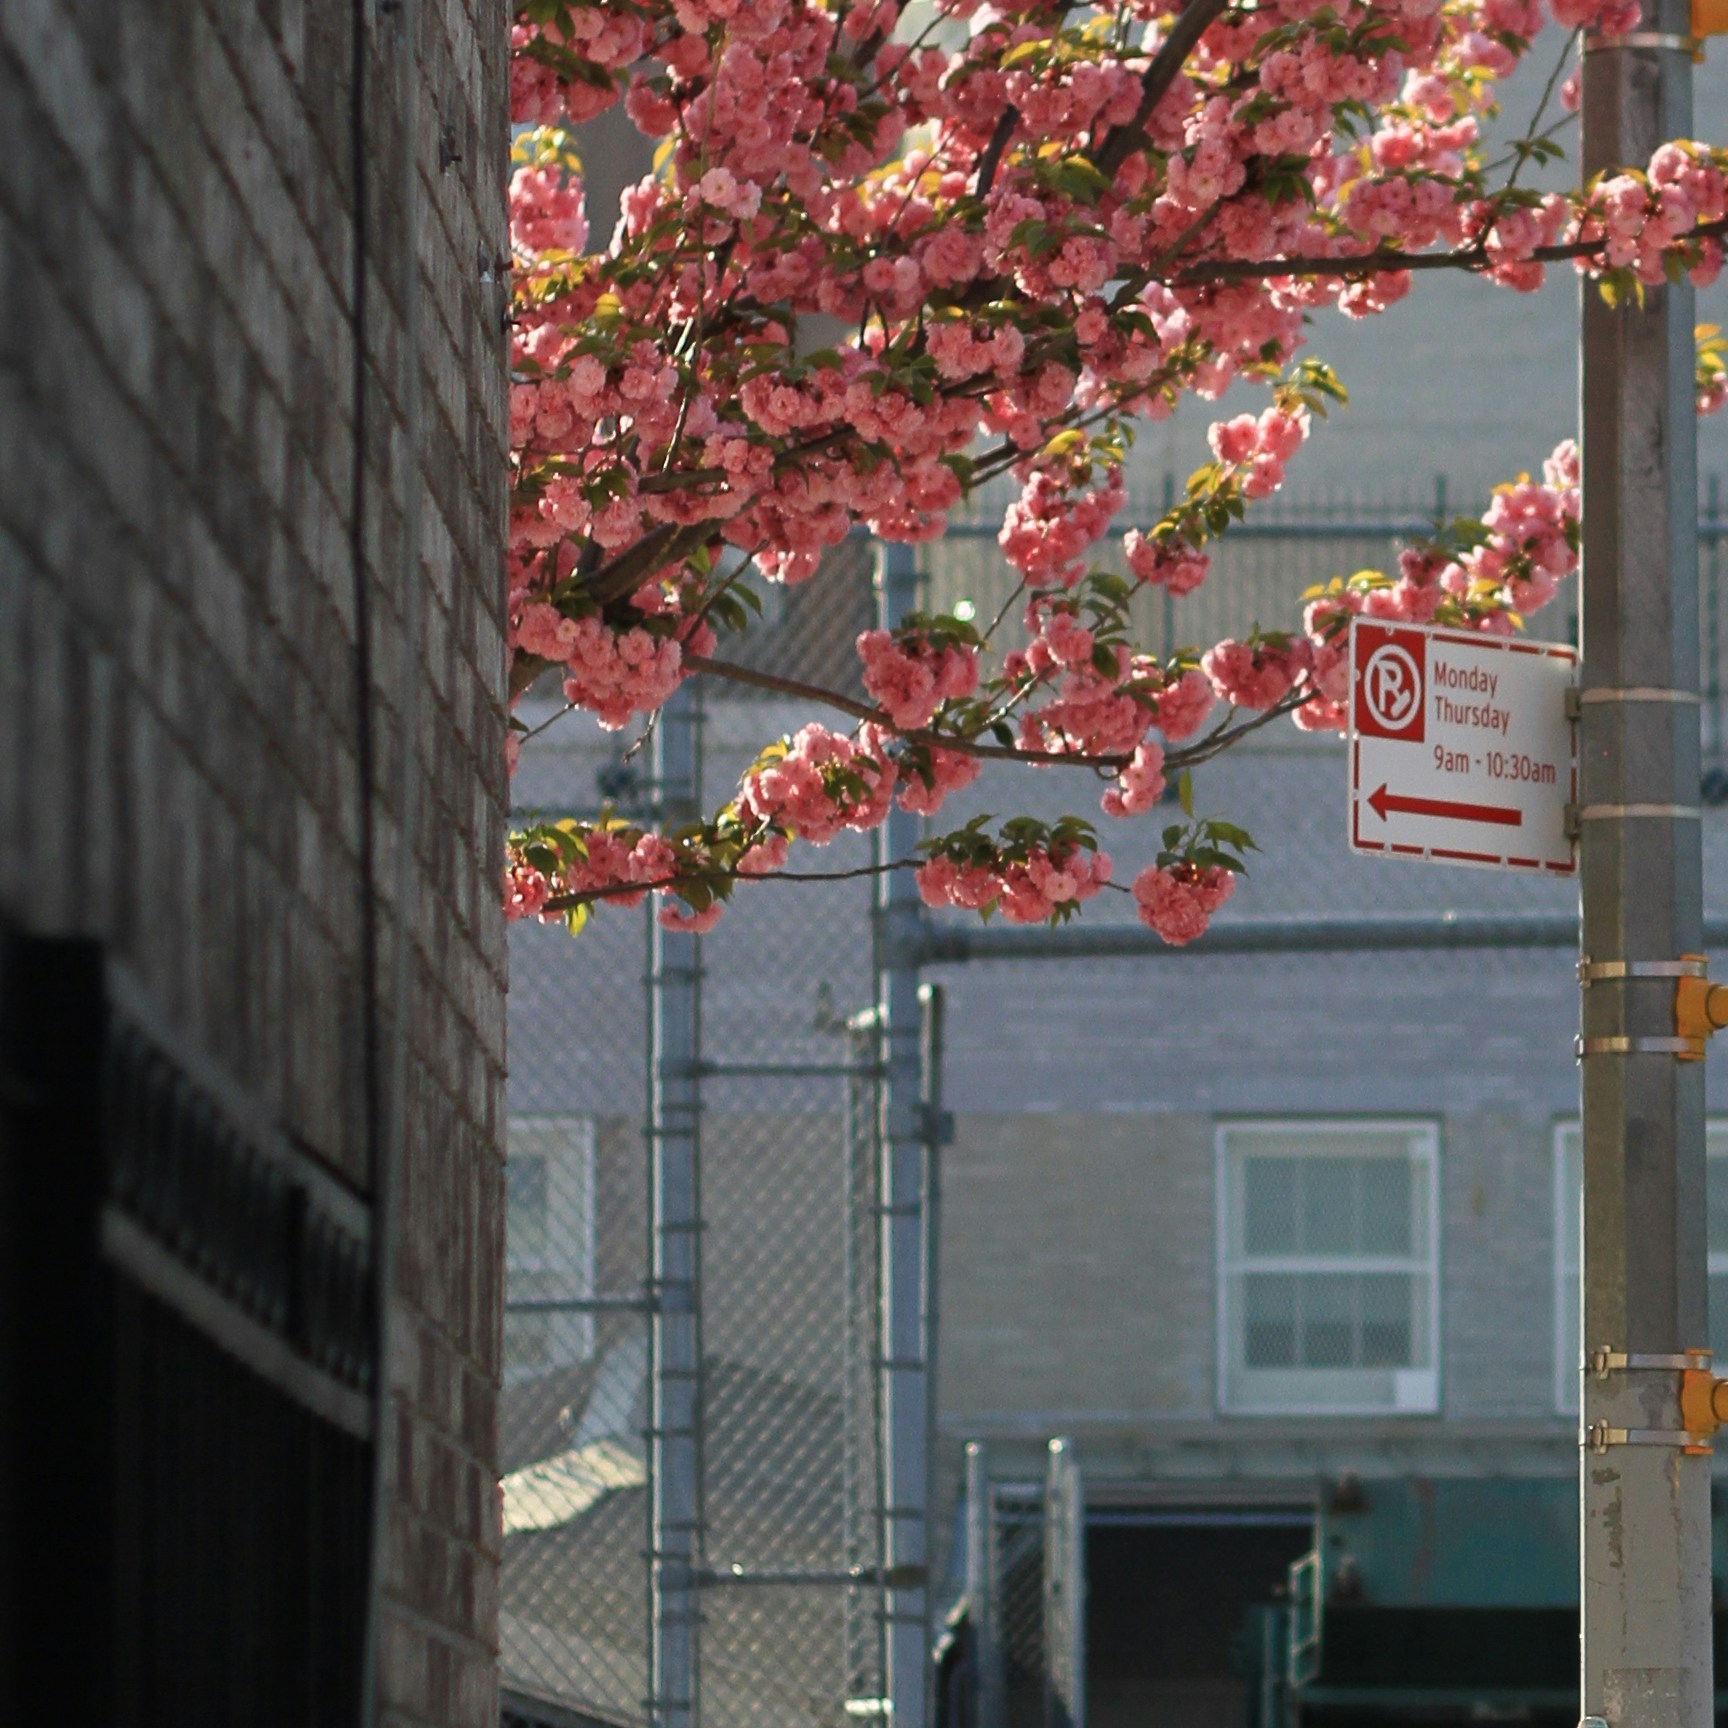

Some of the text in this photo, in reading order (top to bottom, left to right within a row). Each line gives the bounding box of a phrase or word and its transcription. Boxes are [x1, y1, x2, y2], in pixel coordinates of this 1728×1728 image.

[1434, 661, 1498, 699] Monday
[1435, 695, 1510, 736] Thursday
[1434, 744, 1470, 774] 9am
[1486, 751, 1556, 784] 10:30am
